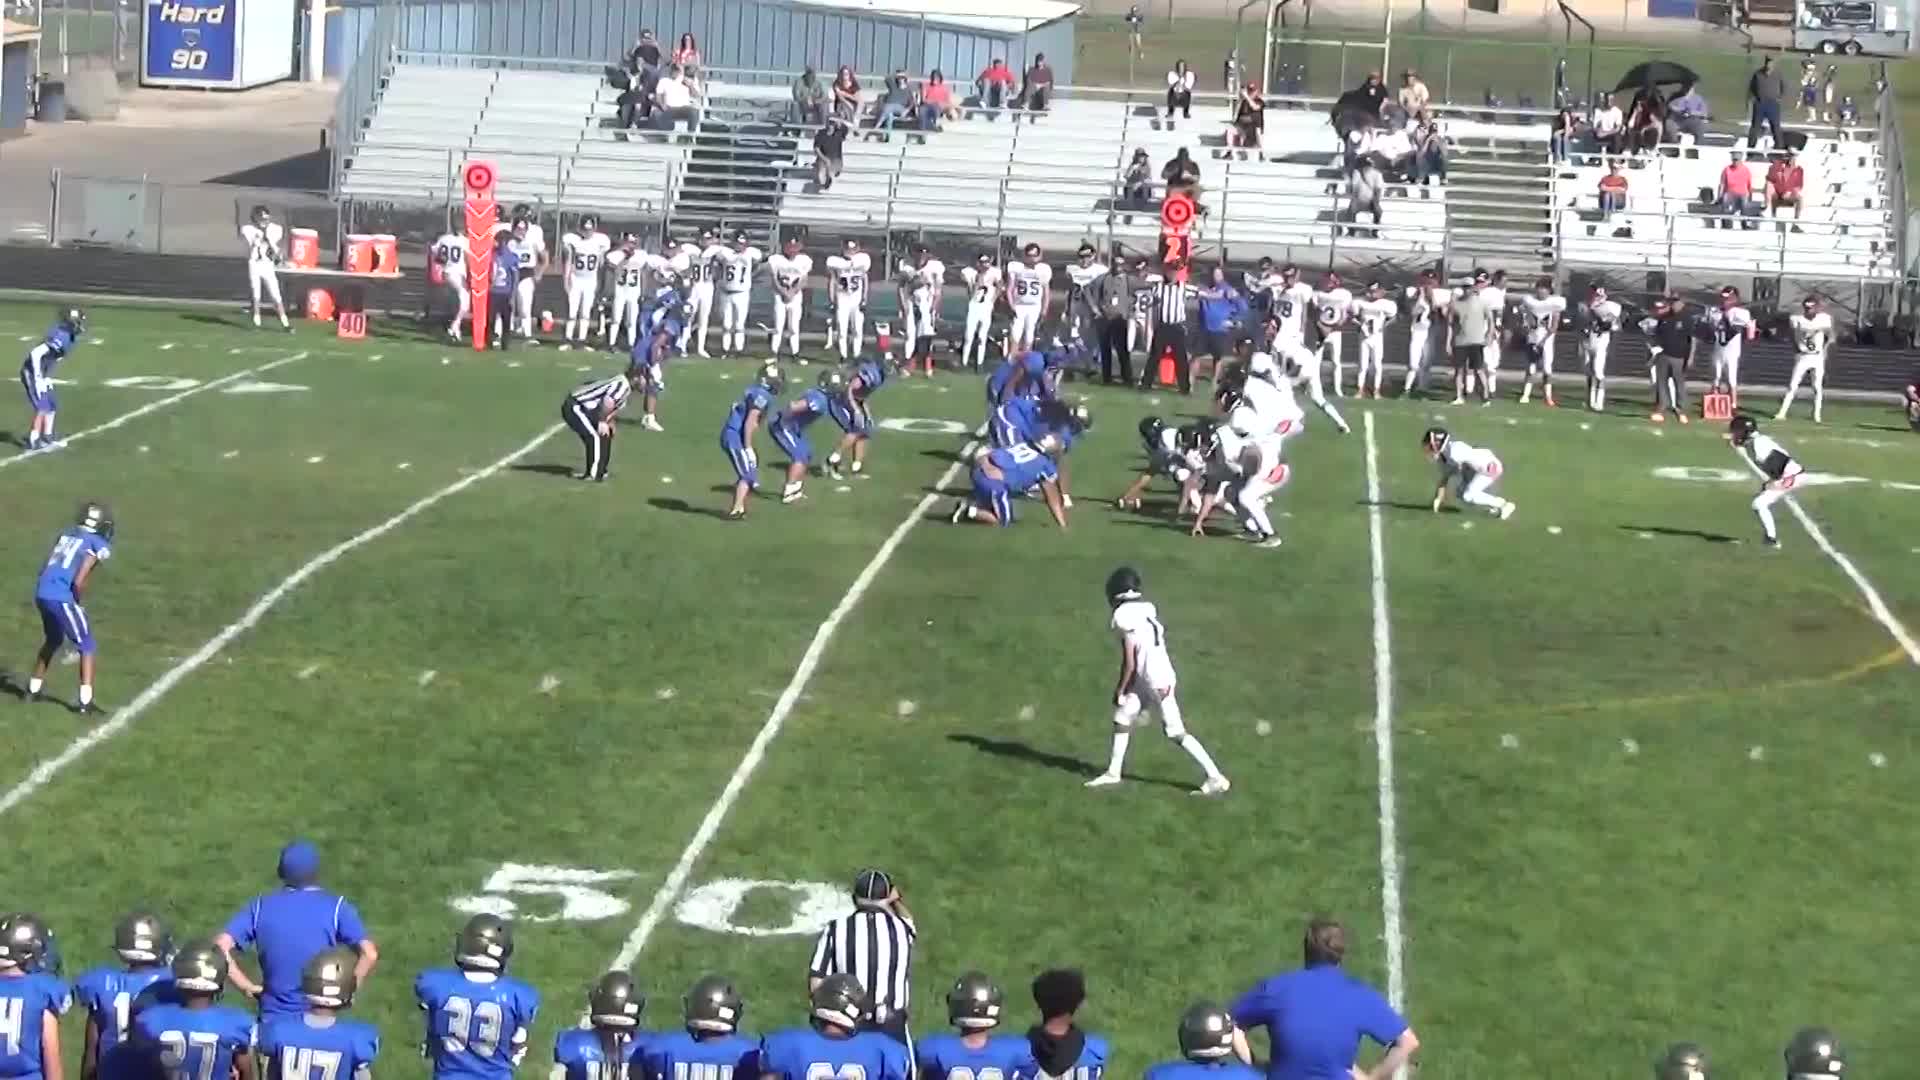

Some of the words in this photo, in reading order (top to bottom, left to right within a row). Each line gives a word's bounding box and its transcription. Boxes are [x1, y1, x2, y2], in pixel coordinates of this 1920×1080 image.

[160, 2, 225, 24] Hard
[170, 48, 209, 70] 90
[1163, 236, 1182, 264] 2
[340, 312, 364, 335] 40
